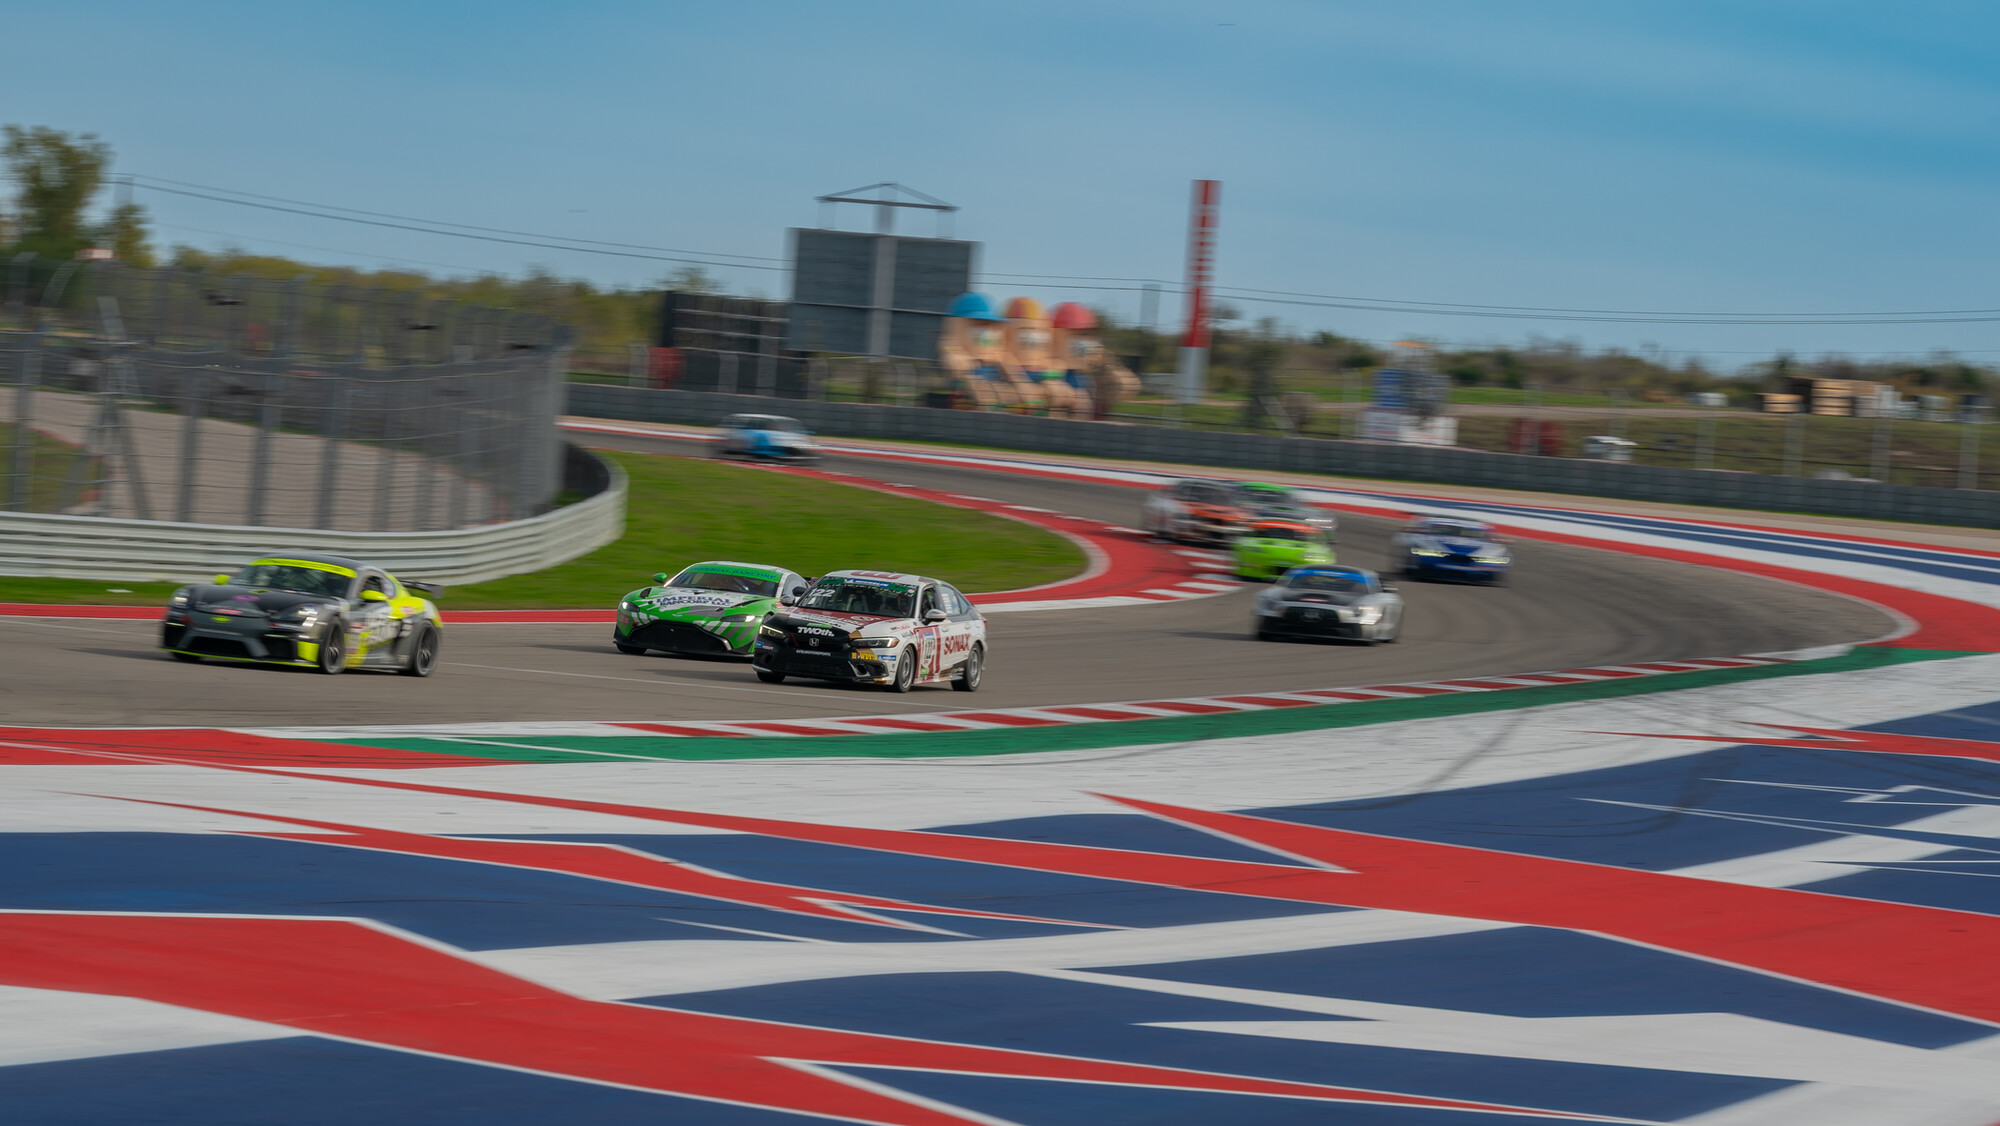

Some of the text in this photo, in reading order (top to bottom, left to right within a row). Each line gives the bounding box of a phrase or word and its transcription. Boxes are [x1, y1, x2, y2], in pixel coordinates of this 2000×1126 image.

[733, 569, 777, 579] BANCORP
[808, 588, 836, 598] 122
[657, 596, 733, 604] IMPERIAL
[944, 633, 971, 655] SONAX
